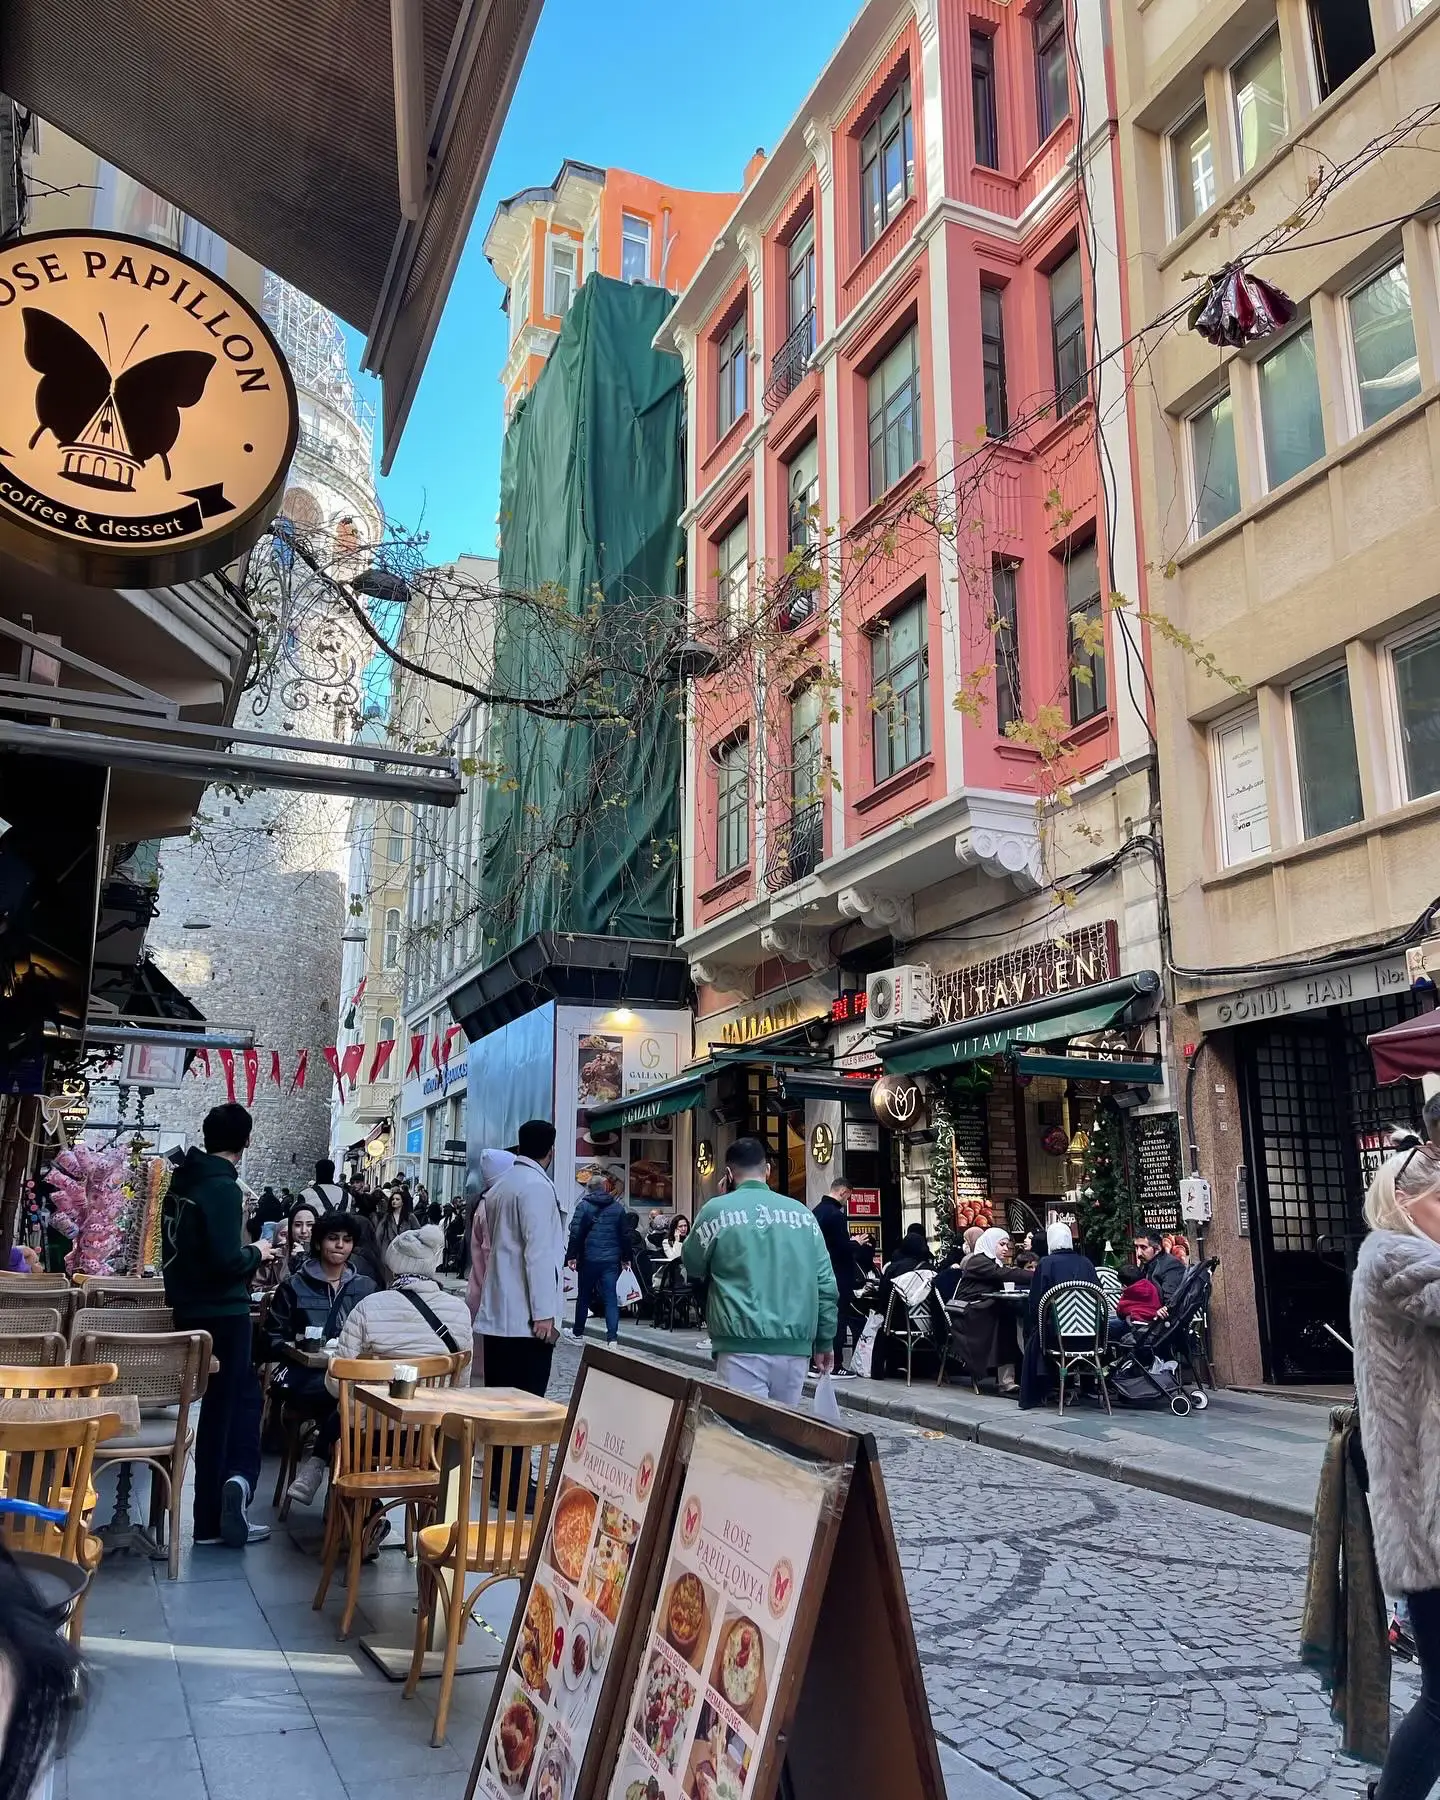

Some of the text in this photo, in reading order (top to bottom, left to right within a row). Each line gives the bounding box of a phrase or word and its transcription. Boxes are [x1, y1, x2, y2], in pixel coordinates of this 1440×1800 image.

[83, 251, 270, 393] PAPILLON
[0, 482, 184, 537] coffee & dessert
[894, 975, 902, 1015] VESTEL
[1217, 968, 1405, 1023] GÖNÜL HAN No:
[952, 1023, 1037, 1057] VITAVIEN
[629, 1071, 671, 1080] GALLANT
[628, 1100, 663, 1123] GALLANT
[1144, 1215, 1177, 1224] KRUVASAN
[604, 1431, 626, 1457] ROSE
[723, 1519, 752, 1554] ROSE
